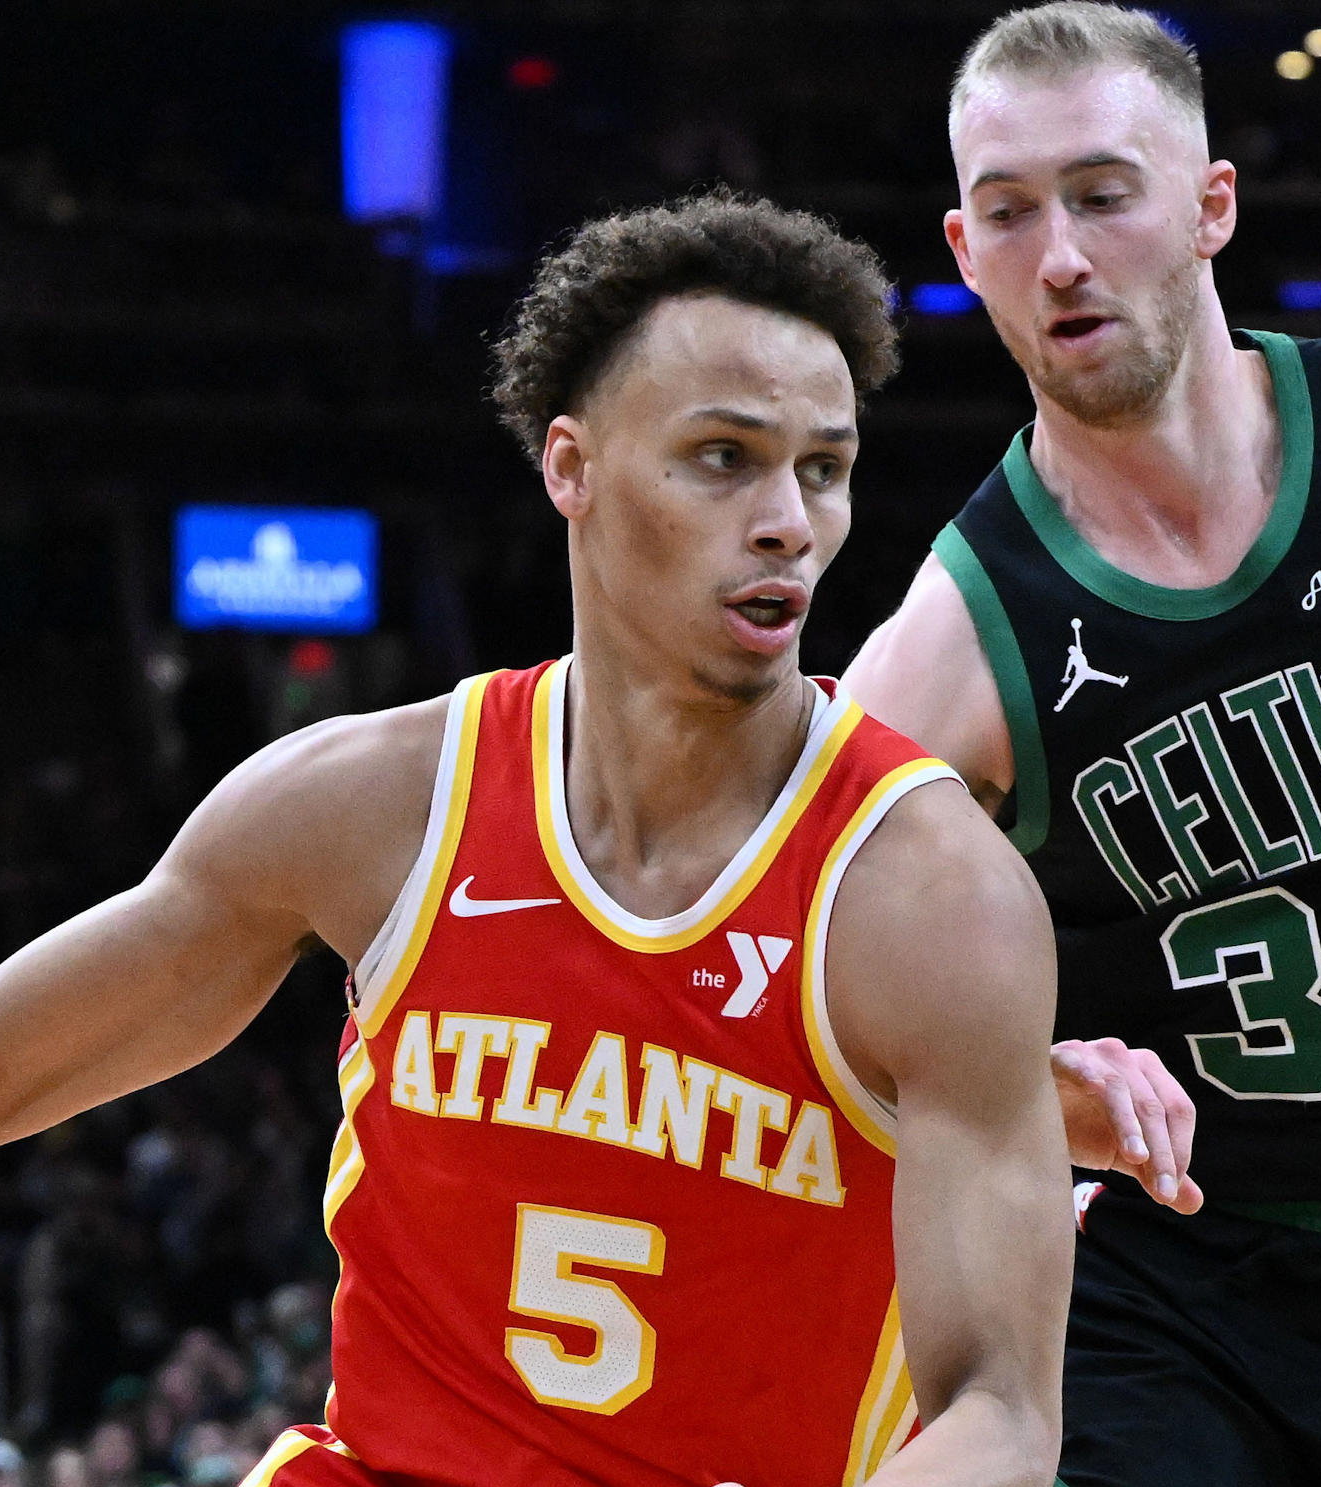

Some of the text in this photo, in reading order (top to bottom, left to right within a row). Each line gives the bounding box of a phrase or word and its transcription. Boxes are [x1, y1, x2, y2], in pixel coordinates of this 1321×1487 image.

[692, 967, 726, 989] the
[750, 996, 768, 1019] YMCA
[390, 1010, 847, 1208] ATLANTA
[504, 1202, 666, 1416] 5
